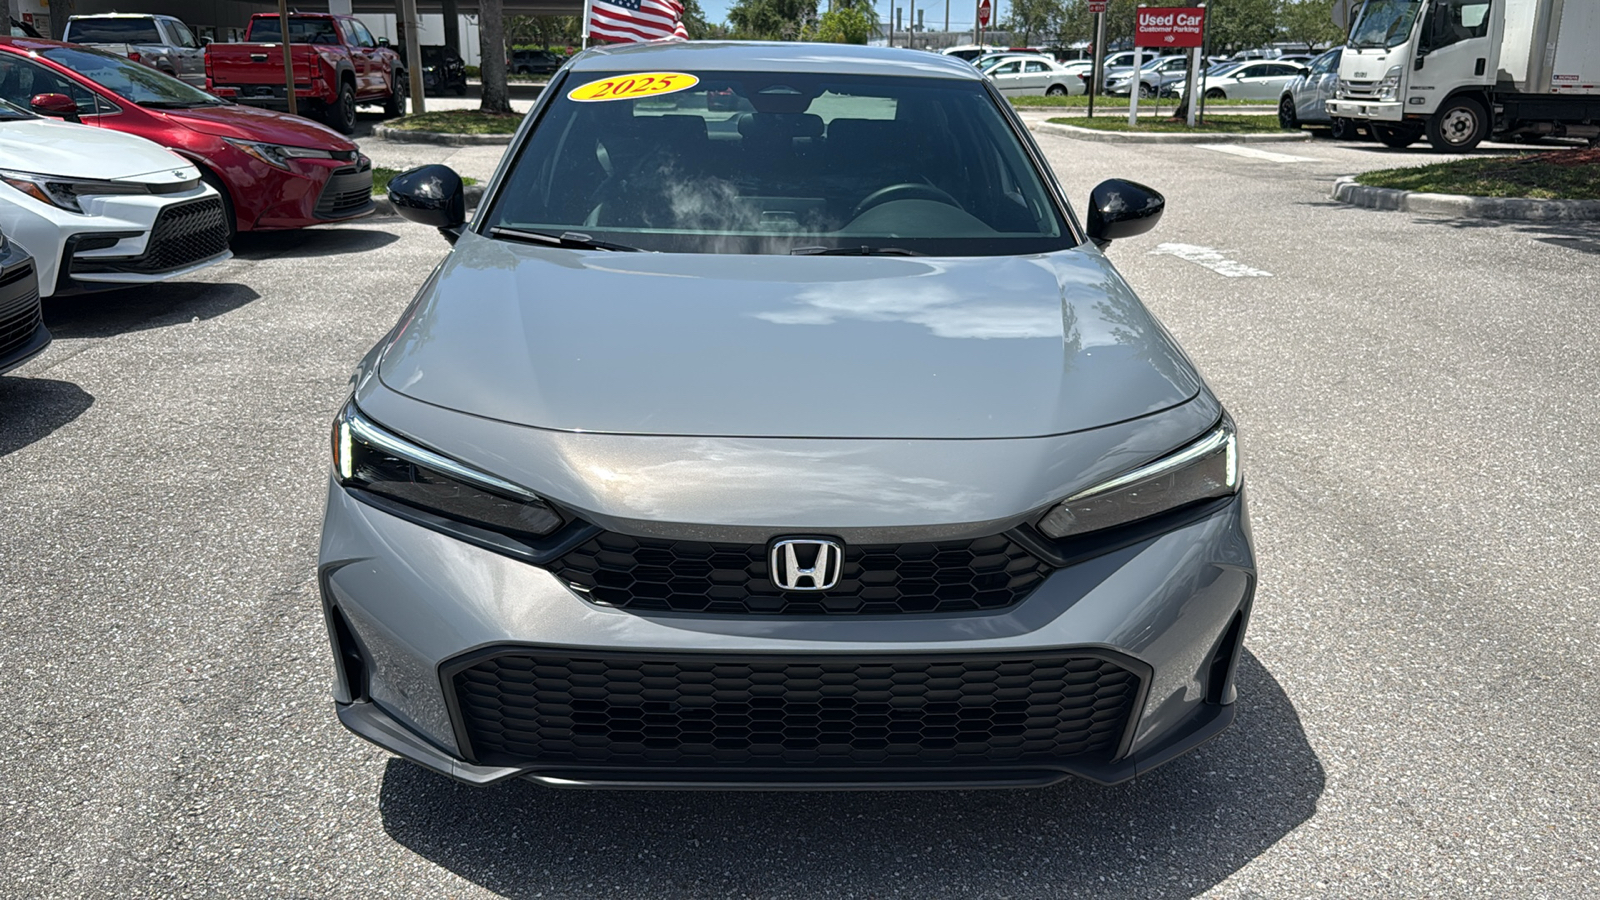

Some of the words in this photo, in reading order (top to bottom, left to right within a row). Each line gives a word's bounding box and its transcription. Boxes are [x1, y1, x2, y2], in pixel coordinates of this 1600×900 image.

[1139, 14, 1174, 26] Used
[1177, 14, 1202, 26] Car
[589, 76, 677, 98] 2025
